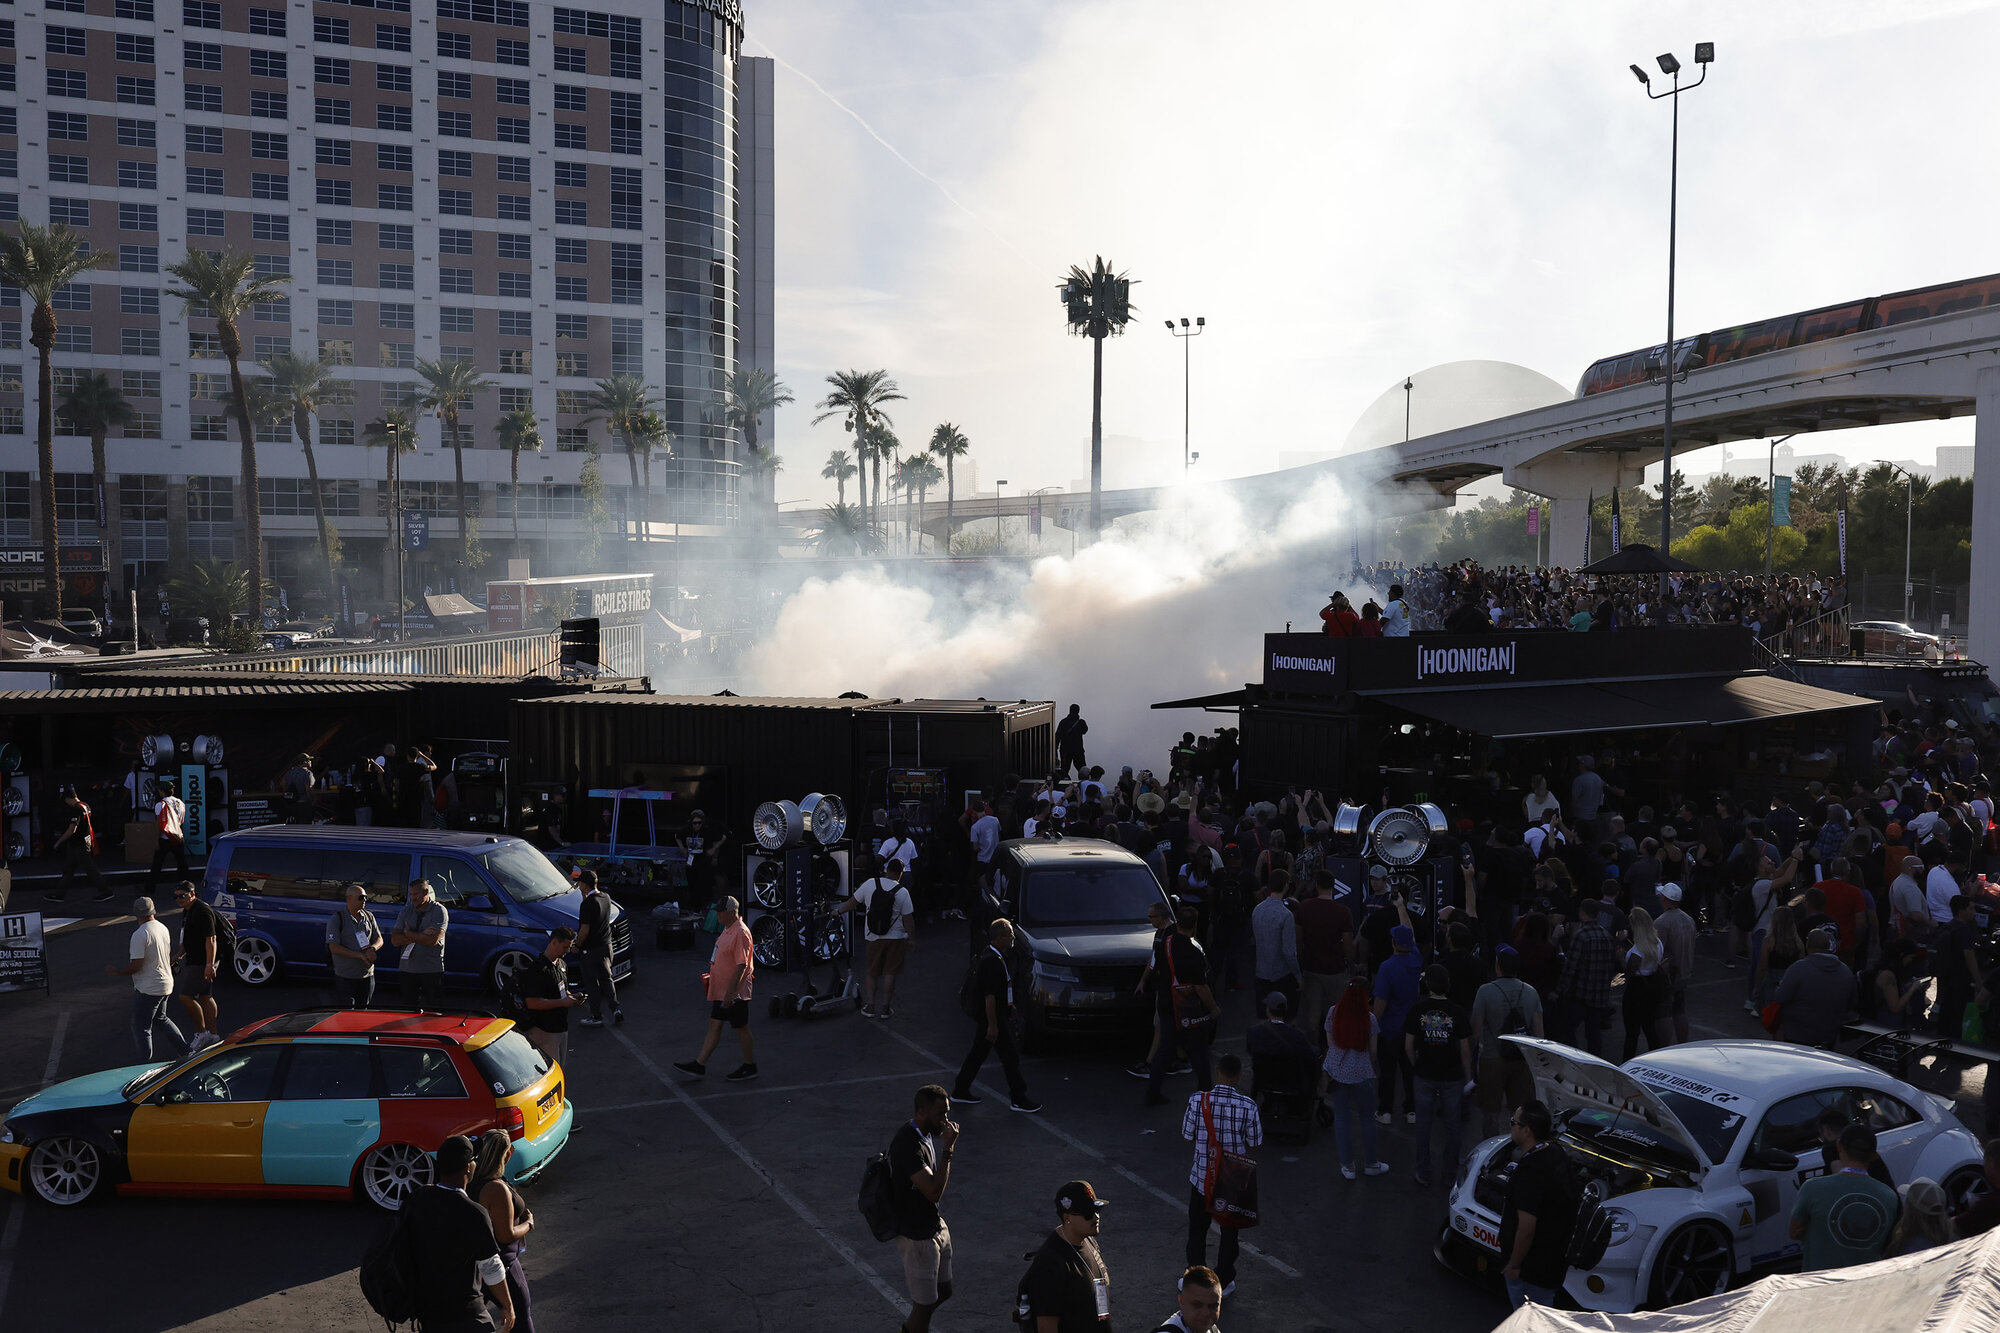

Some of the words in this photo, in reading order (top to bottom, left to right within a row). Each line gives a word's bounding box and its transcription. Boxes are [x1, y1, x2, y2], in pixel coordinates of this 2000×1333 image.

[413, 536, 420, 546] 3
[594, 591, 627, 616] RCULES
[628, 589, 651, 612] TIRES
[1272, 652, 1336, 675] [HOONIGAN]
[1417, 641, 1516, 680] [HOONIGAN]
[187, 774, 203, 836] rotiform
[1425, 1030, 1448, 1039] VANS
[1642, 1069, 1670, 1081] GRAN
[1668, 1076, 1713, 1095] TURISMO
[1473, 1226, 1504, 1248] SONA
